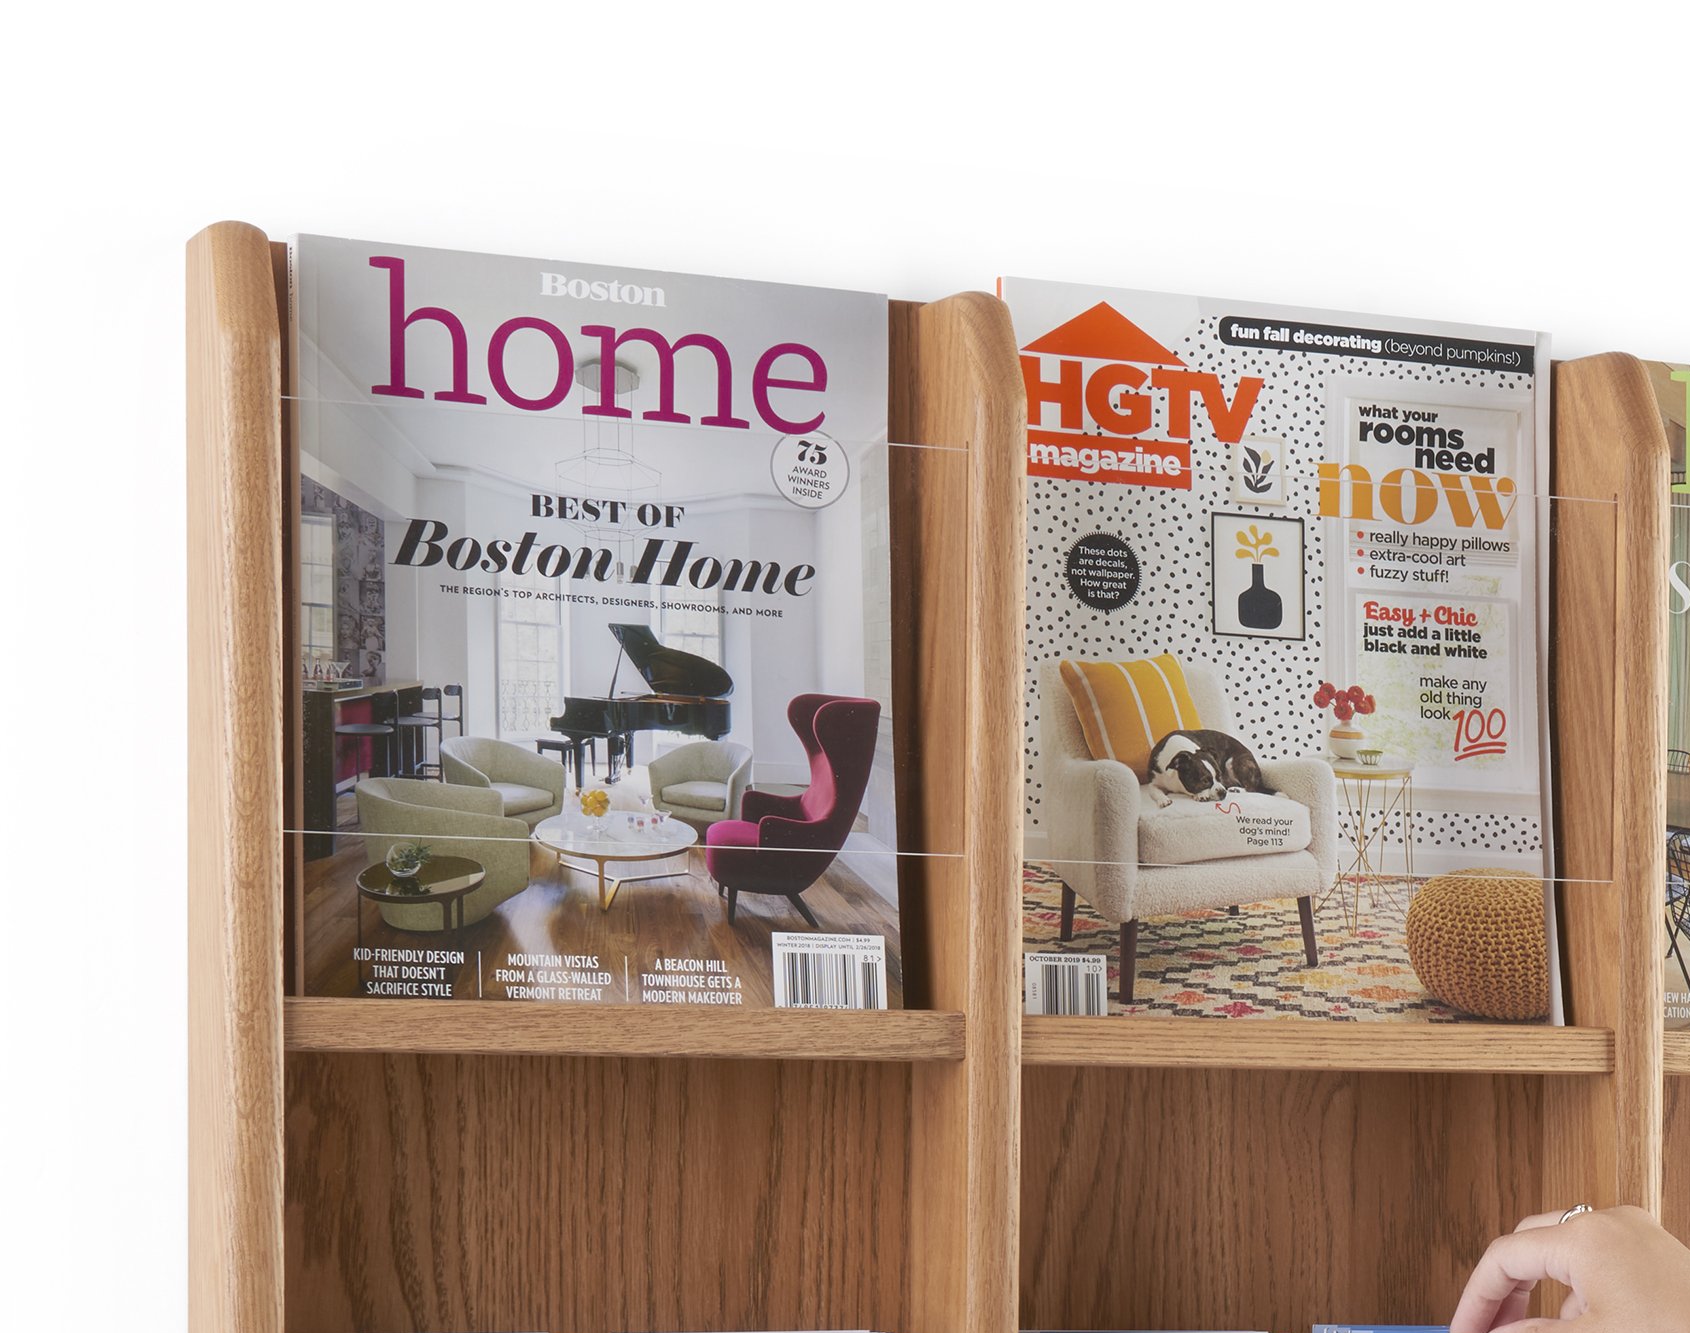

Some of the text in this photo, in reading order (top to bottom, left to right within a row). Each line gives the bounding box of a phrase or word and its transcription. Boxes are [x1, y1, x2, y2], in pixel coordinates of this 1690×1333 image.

[540, 272, 667, 307] Boston
[369, 255, 828, 435] home
[1230, 323, 1521, 367] fun fall decorating (beyond pumpkins!)
[1019, 354, 1265, 444] HGTV
[1359, 405, 1438, 425] what your
[1359, 420, 1465, 450] rooms
[797, 440, 828, 465] 75
[1030, 443, 1182, 476] magazine
[1415, 448, 1496, 475] need
[787, 475, 830, 490] WINNERS
[792, 466, 827, 479] AWARD
[792, 487, 823, 499] INSIDE
[1310, 462, 1518, 531] now
[530, 493, 685, 529] BEST OF
[1369, 530, 1510, 553] really happy pillows
[388, 517, 816, 597] Boston Home
[1369, 549, 1466, 567] extra-cool art
[1370, 565, 1450, 583] fuzzy stuff!
[440, 585, 783, 618] THE REGION'S TOP ARCHITECTS, DESIGNERS, SHOWROOMS, AND MORE
[1363, 601, 1416, 627] Easy
[1433, 605, 1479, 627] Chic
[1363, 622, 1481, 643] just add a little
[1364, 639, 1488, 659] black and white
[1419, 675, 1488, 693] make any
[1419, 691, 1483, 709] old thing
[1420, 706, 1507, 752] look 100
